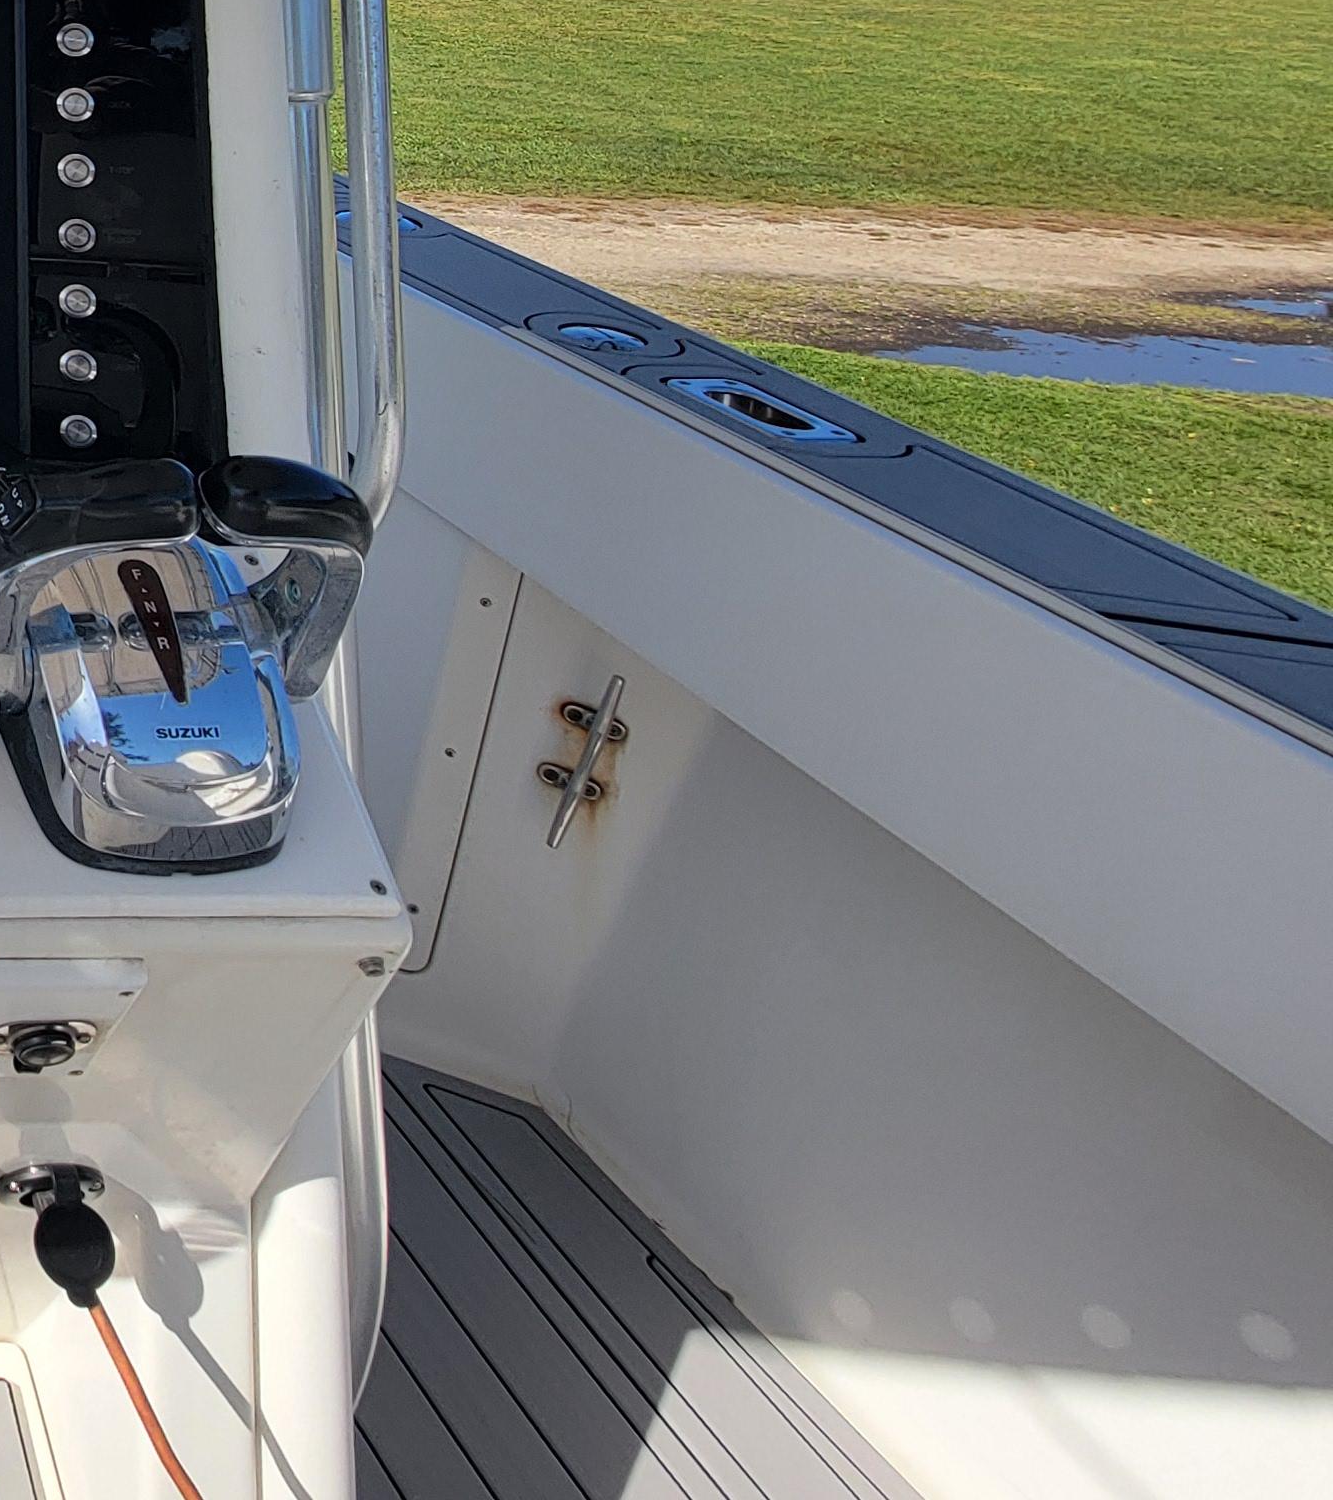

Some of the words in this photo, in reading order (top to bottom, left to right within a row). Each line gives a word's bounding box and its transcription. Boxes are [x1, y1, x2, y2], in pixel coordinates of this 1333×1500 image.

[131, 568, 142, 581] F
[143, 600, 158, 614] N
[156, 636, 171, 650] R
[155, 726, 220, 740] SUZUKI
